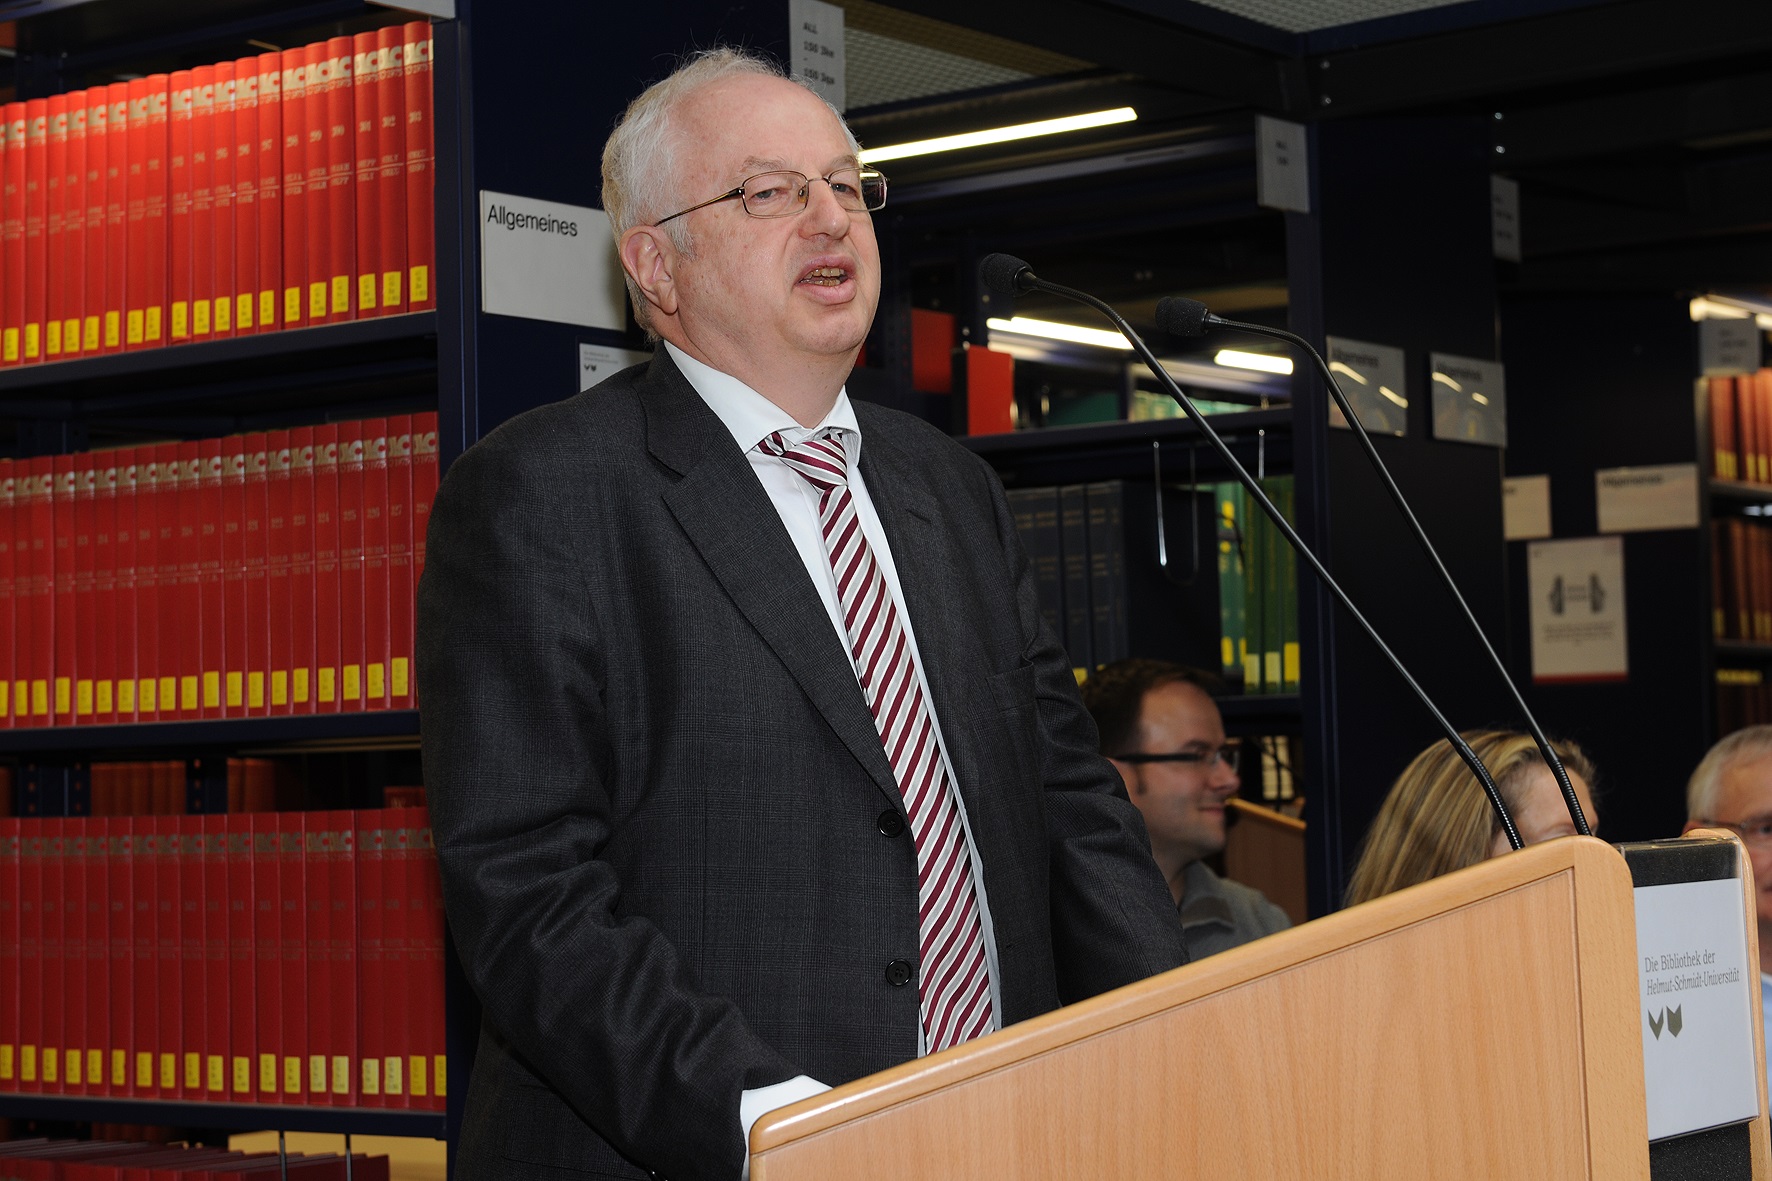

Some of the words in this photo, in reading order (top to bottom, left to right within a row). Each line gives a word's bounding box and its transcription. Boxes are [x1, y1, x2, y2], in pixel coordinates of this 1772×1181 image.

[488, 204, 578, 237] Allgemeines
[1645, 957, 1658, 973] Die
[1660, 950, 1701, 970] Bibliothek
[1703, 949, 1715, 965] der
[1647, 968, 1740, 996] Helmut-Schmidt-Universität
